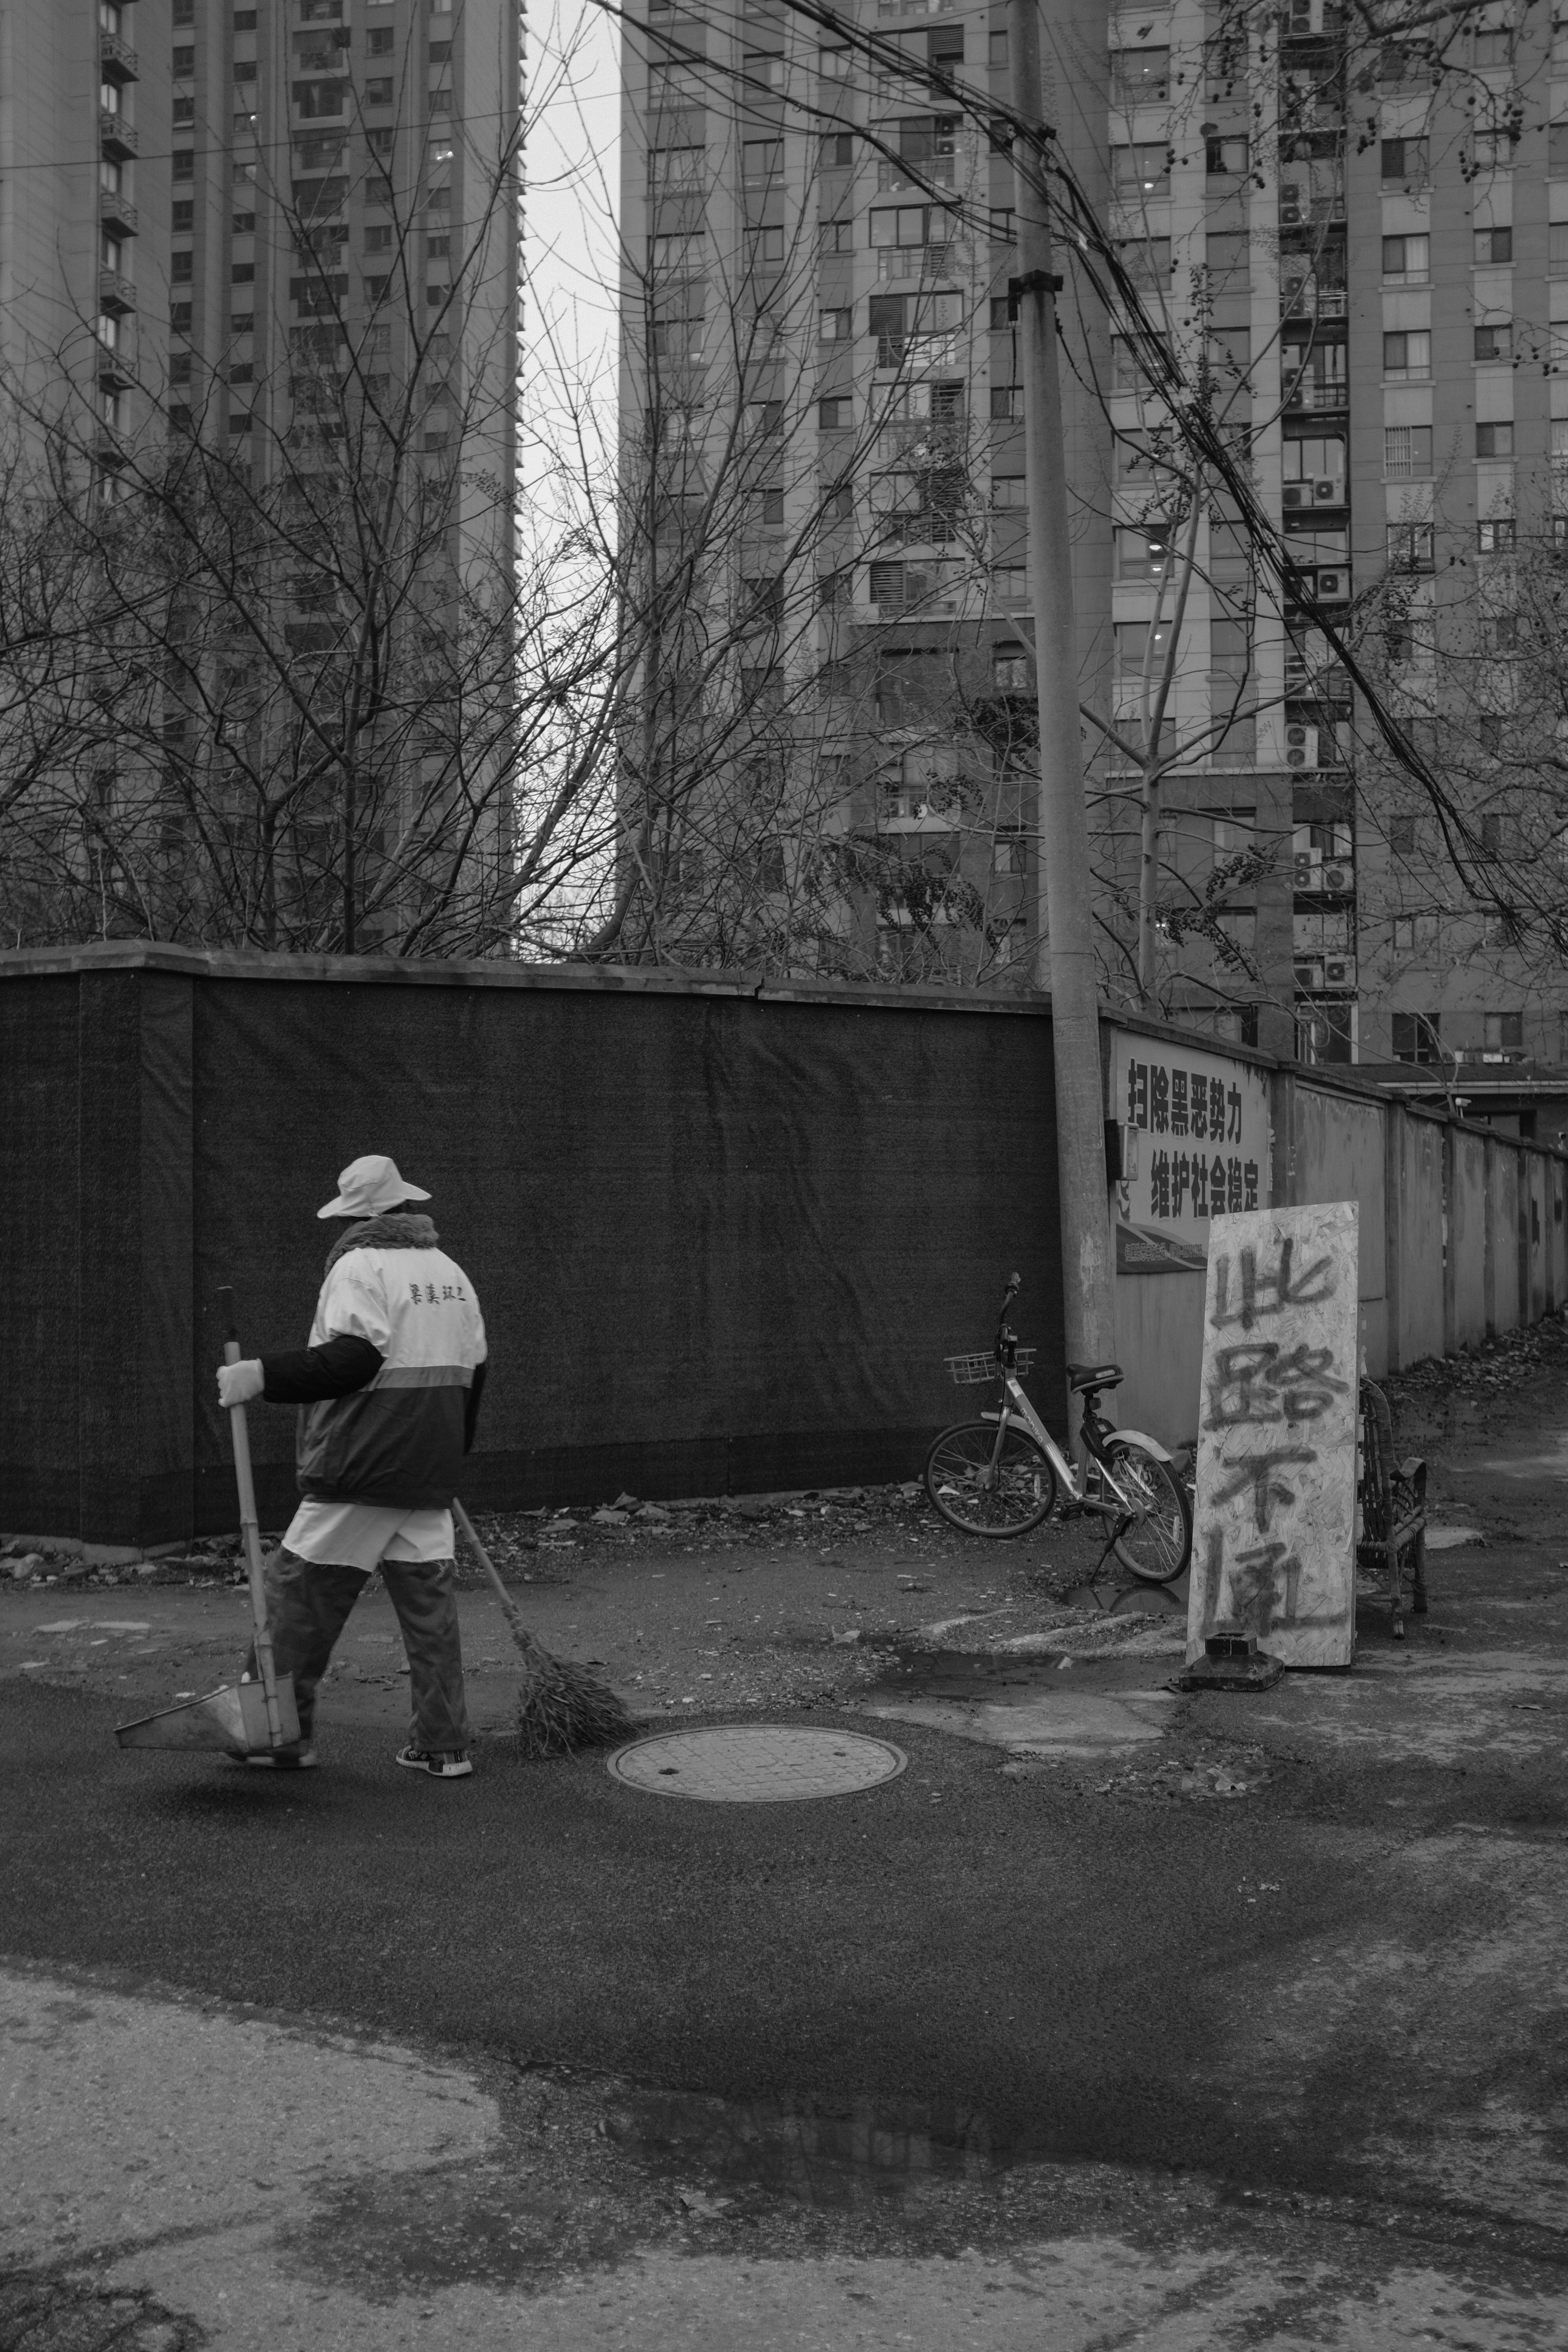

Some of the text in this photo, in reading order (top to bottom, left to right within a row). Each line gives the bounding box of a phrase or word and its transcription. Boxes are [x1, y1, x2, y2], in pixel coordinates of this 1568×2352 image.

[1128, 1058, 1241, 1144] 扫除黑恶势力
[1151, 1149, 1259, 1220] 维护社会稳定
[1021, 1408, 1043, 1443] mobike
[1202, 1238, 1350, 1636] 此路不通
